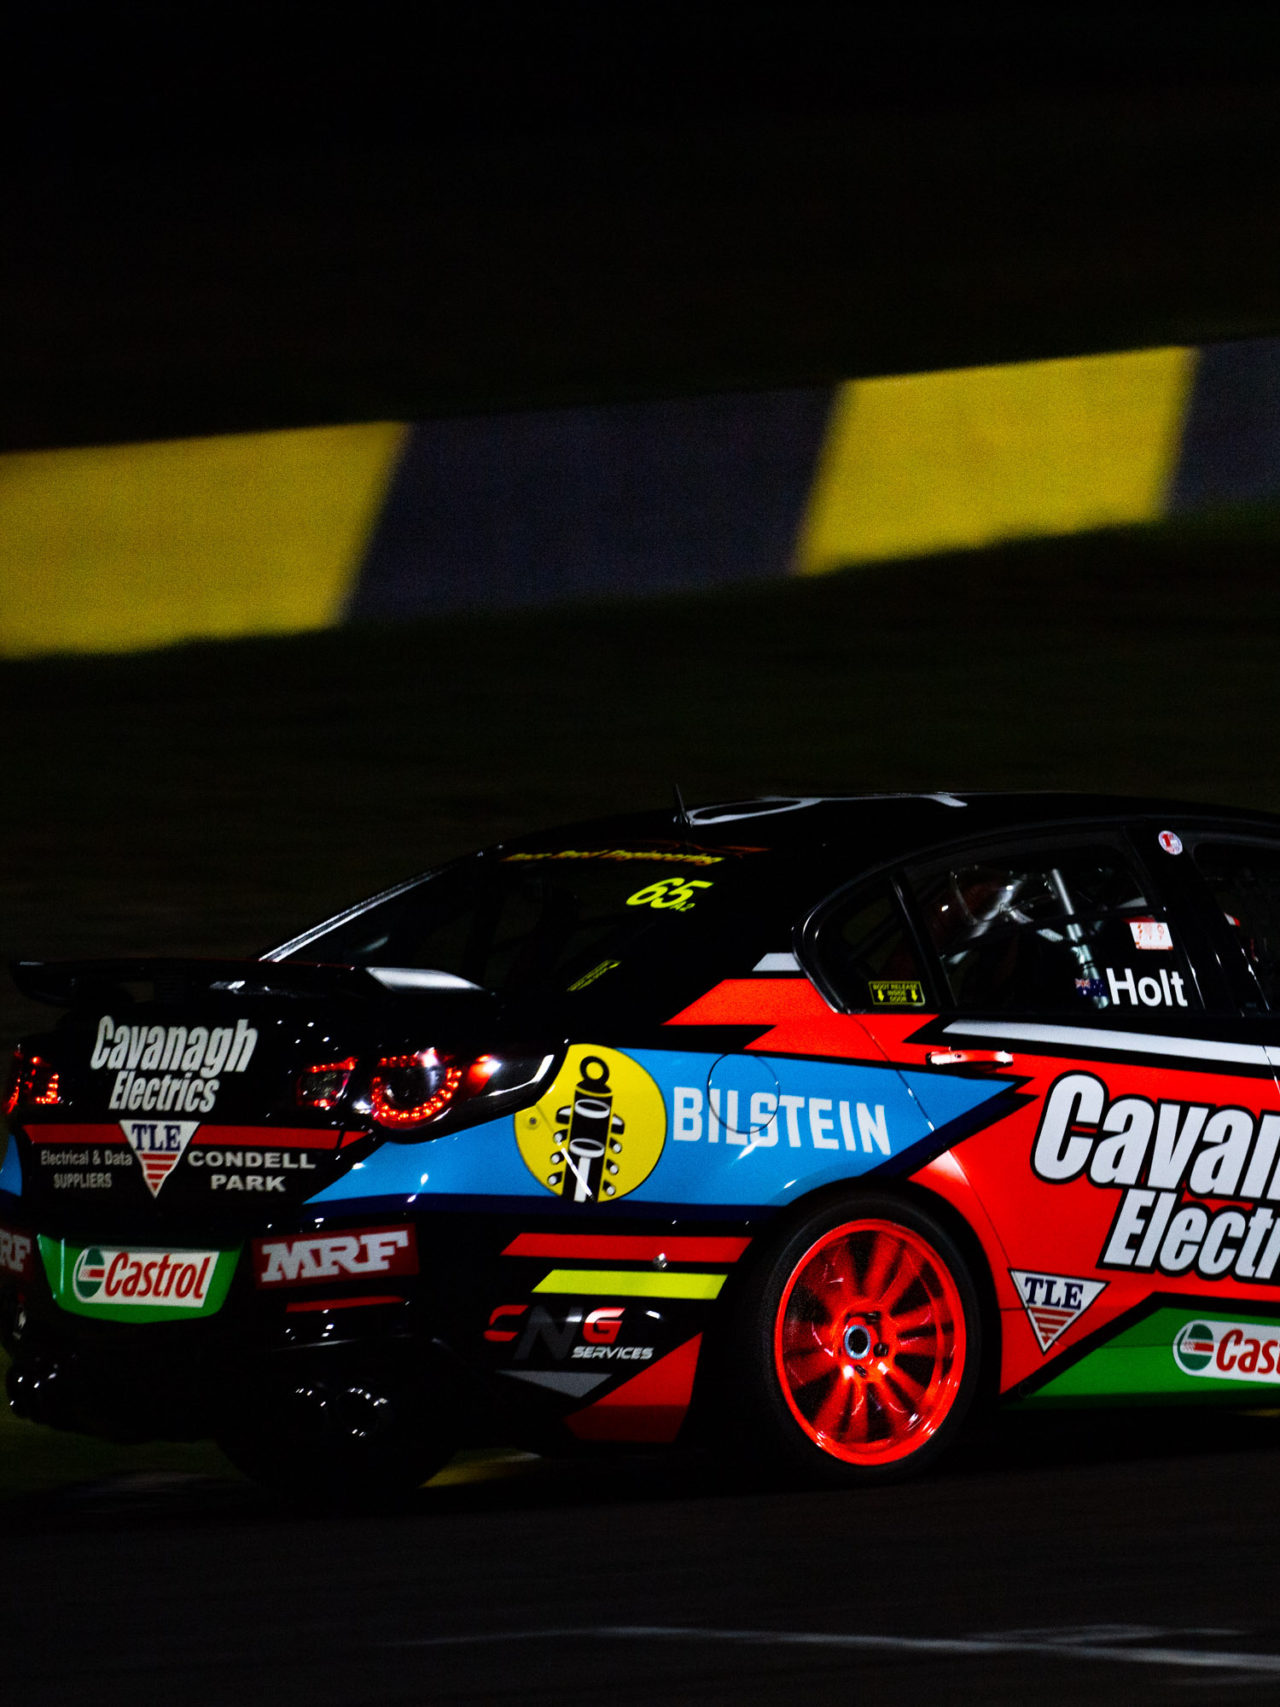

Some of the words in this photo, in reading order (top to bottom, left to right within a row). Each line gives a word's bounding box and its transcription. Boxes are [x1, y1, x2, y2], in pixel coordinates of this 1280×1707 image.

[625, 877, 714, 909] 65
[1106, 967, 1188, 1006] Holt
[90, 1015, 258, 1078] Cavanagh
[109, 1069, 220, 1113] Electrics
[131, 1123, 181, 1152] TLE
[673, 1086, 891, 1156] BILSTEIN
[41, 1149, 89, 1166] Electrical
[92, 1150, 101, 1166] &
[104, 1150, 133, 1166] Data
[188, 1151, 316, 1169] CONDELL
[53, 1173, 112, 1189] SUPPLIERS
[210, 1175, 286, 1192] PARK
[261, 1231, 409, 1282] MRF
[105, 1251, 210, 1300] Castrol
[1023, 1276, 1083, 1310] TLE
[571, 1346, 654, 1360] SERVICES
